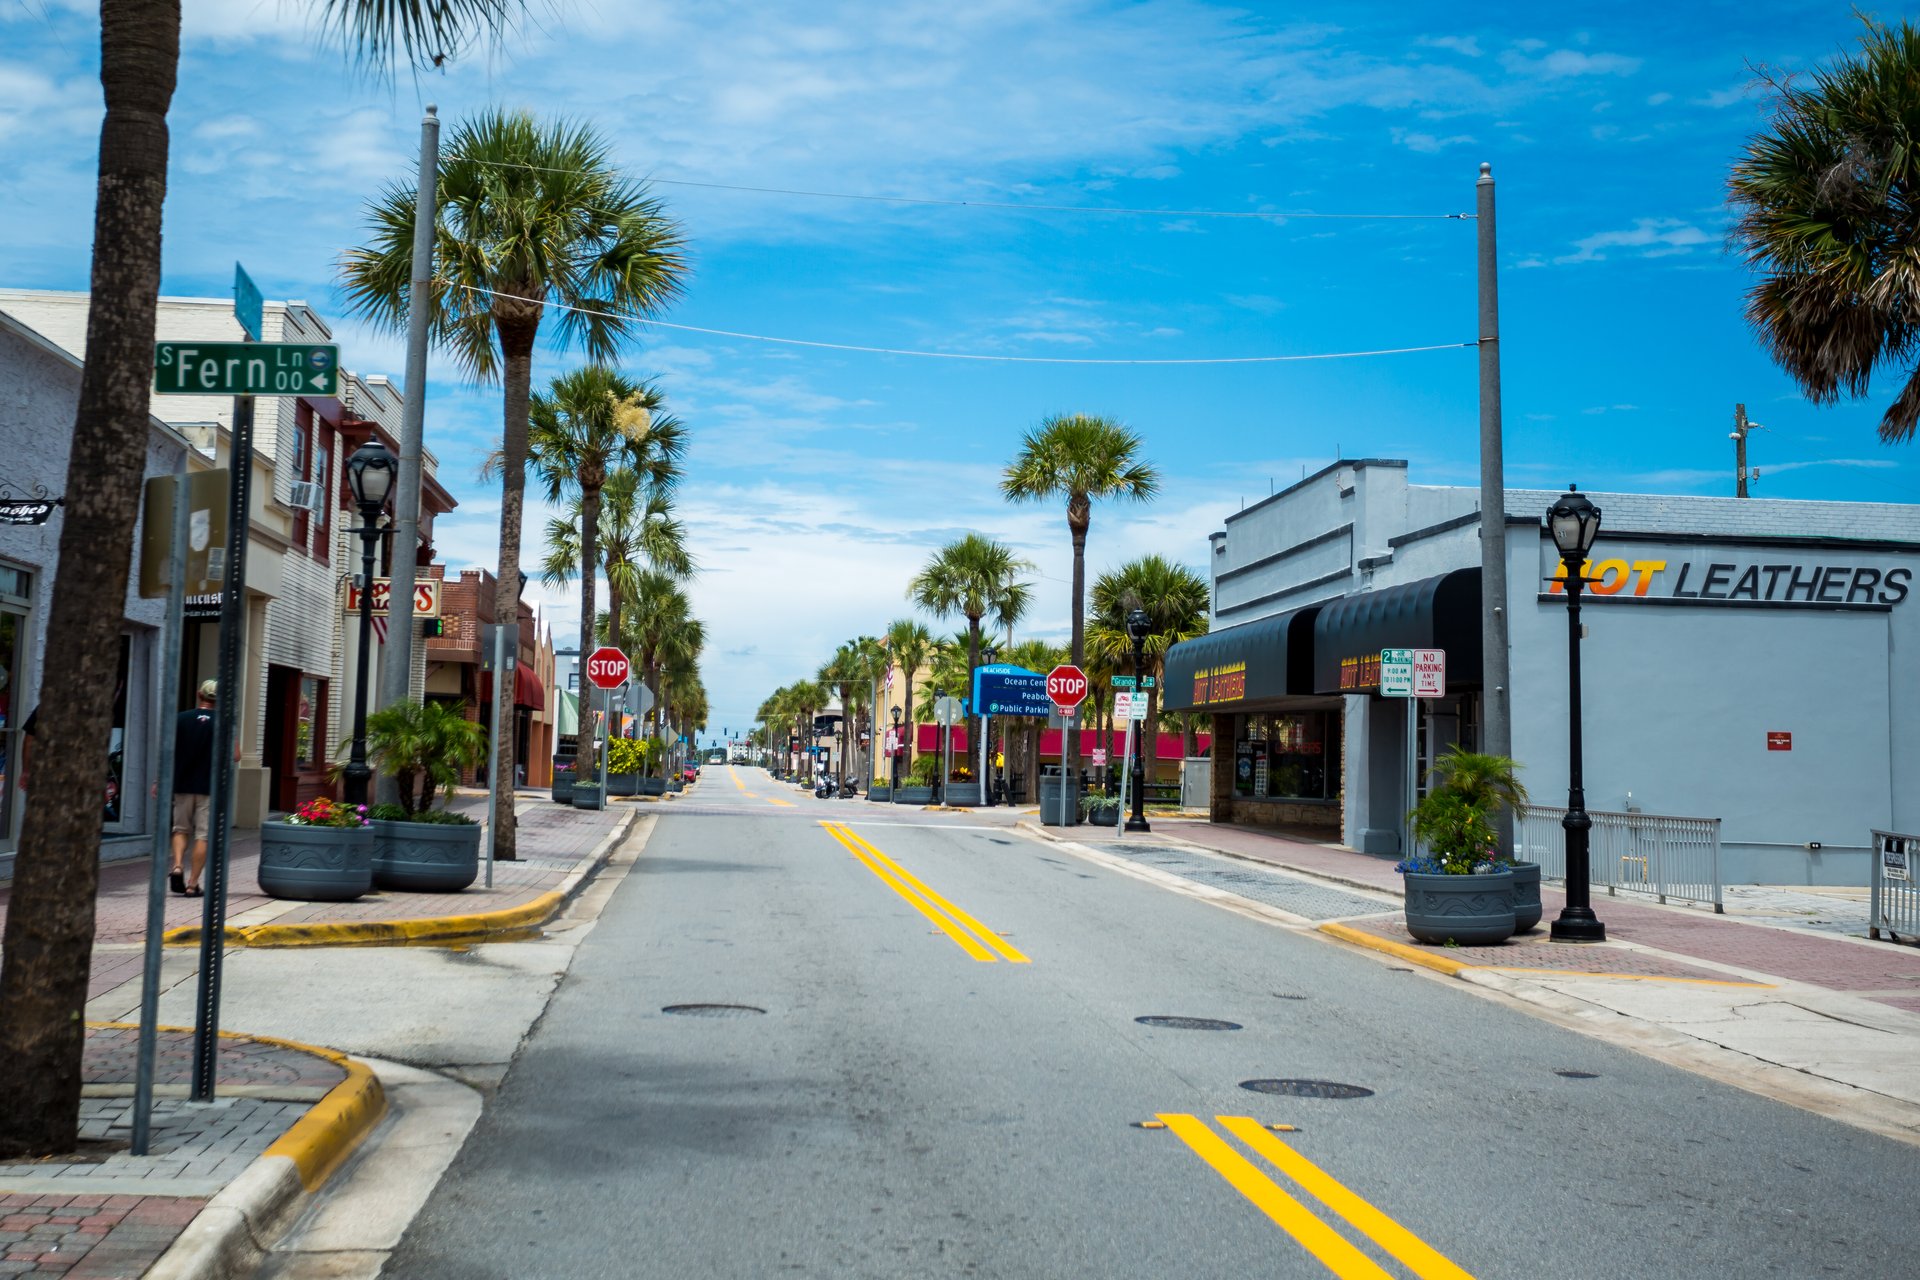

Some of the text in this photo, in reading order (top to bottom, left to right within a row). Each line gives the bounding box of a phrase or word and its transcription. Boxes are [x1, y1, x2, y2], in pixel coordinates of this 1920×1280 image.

[161, 346, 303, 389] S Fern Ln
[1672, 561, 1913, 605] LEATHERS
[1383, 651, 1391, 663] 2
[1423, 653, 1435, 662] NO
[590, 660, 627, 676] STOP
[1415, 663, 1442, 673] PARKING
[1004, 677, 1047, 687] Ocean Cent
[1049, 678, 1085, 695] STOP
[1022, 692, 1054, 702] Peabod
[999, 704, 1023, 713] Public
[1024, 705, 1049, 715] Parkin
